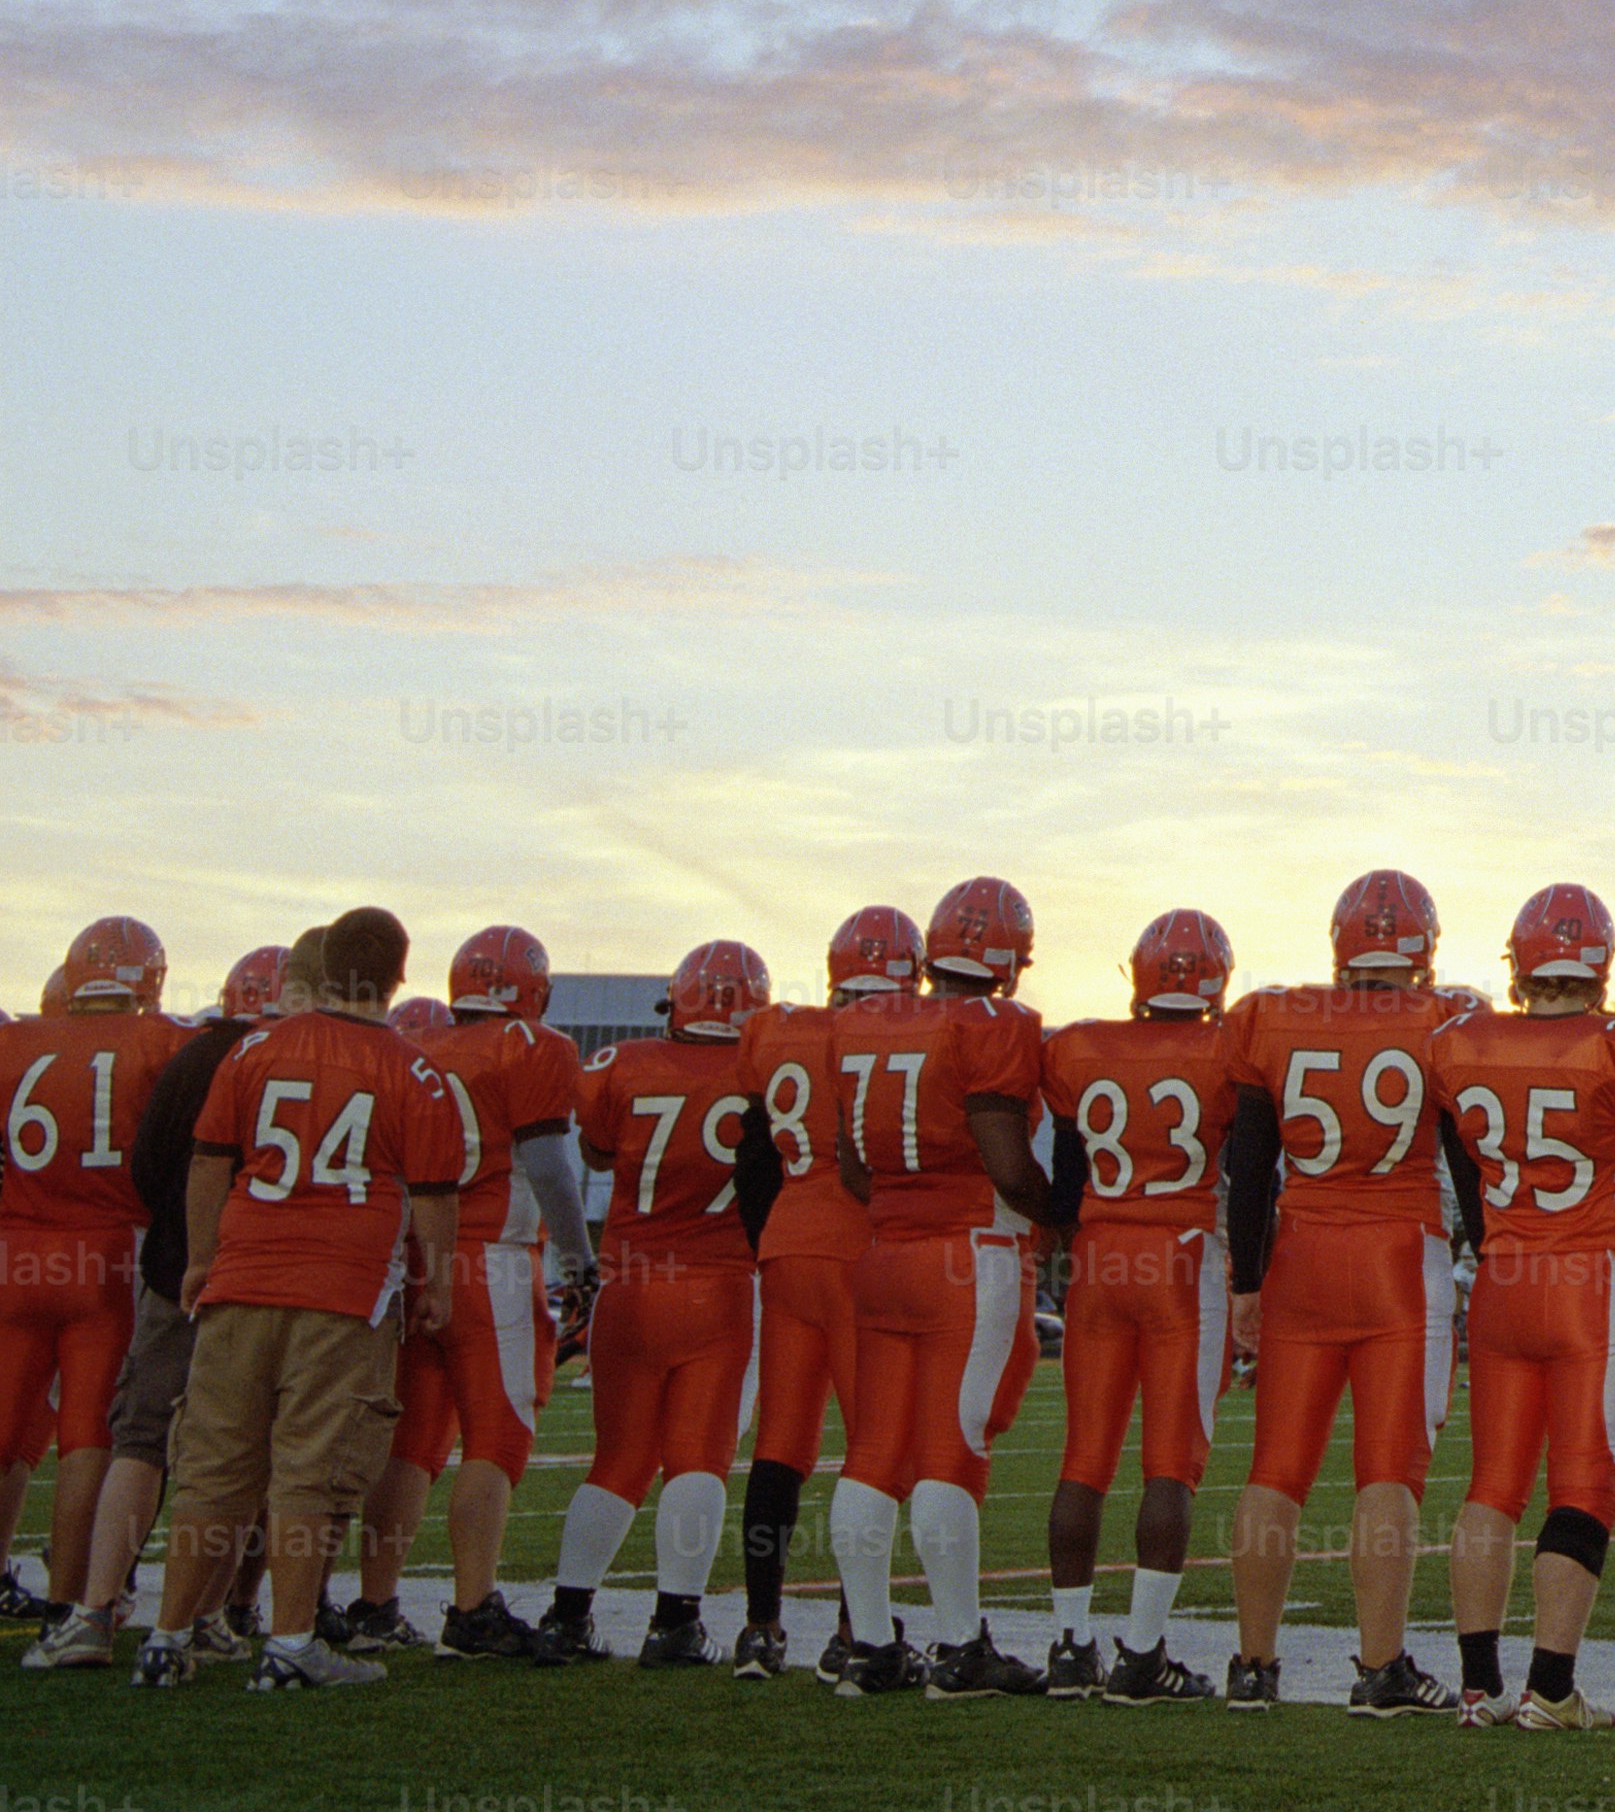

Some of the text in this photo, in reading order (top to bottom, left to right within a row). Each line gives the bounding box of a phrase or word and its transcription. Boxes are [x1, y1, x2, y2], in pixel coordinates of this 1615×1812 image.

[957, 915, 989, 943] 77
[1551, 917, 1582, 941] 40
[8, 1051, 122, 1172] 61
[248, 1079, 377, 1205] 54
[632, 1093, 752, 1215] 79
[765, 1061, 814, 1176] 8
[840, 1052, 927, 1173] 77
[1076, 1079, 1206, 1198] 83
[1283, 1048, 1425, 1176] 59
[1456, 1086, 1595, 1212] 35
